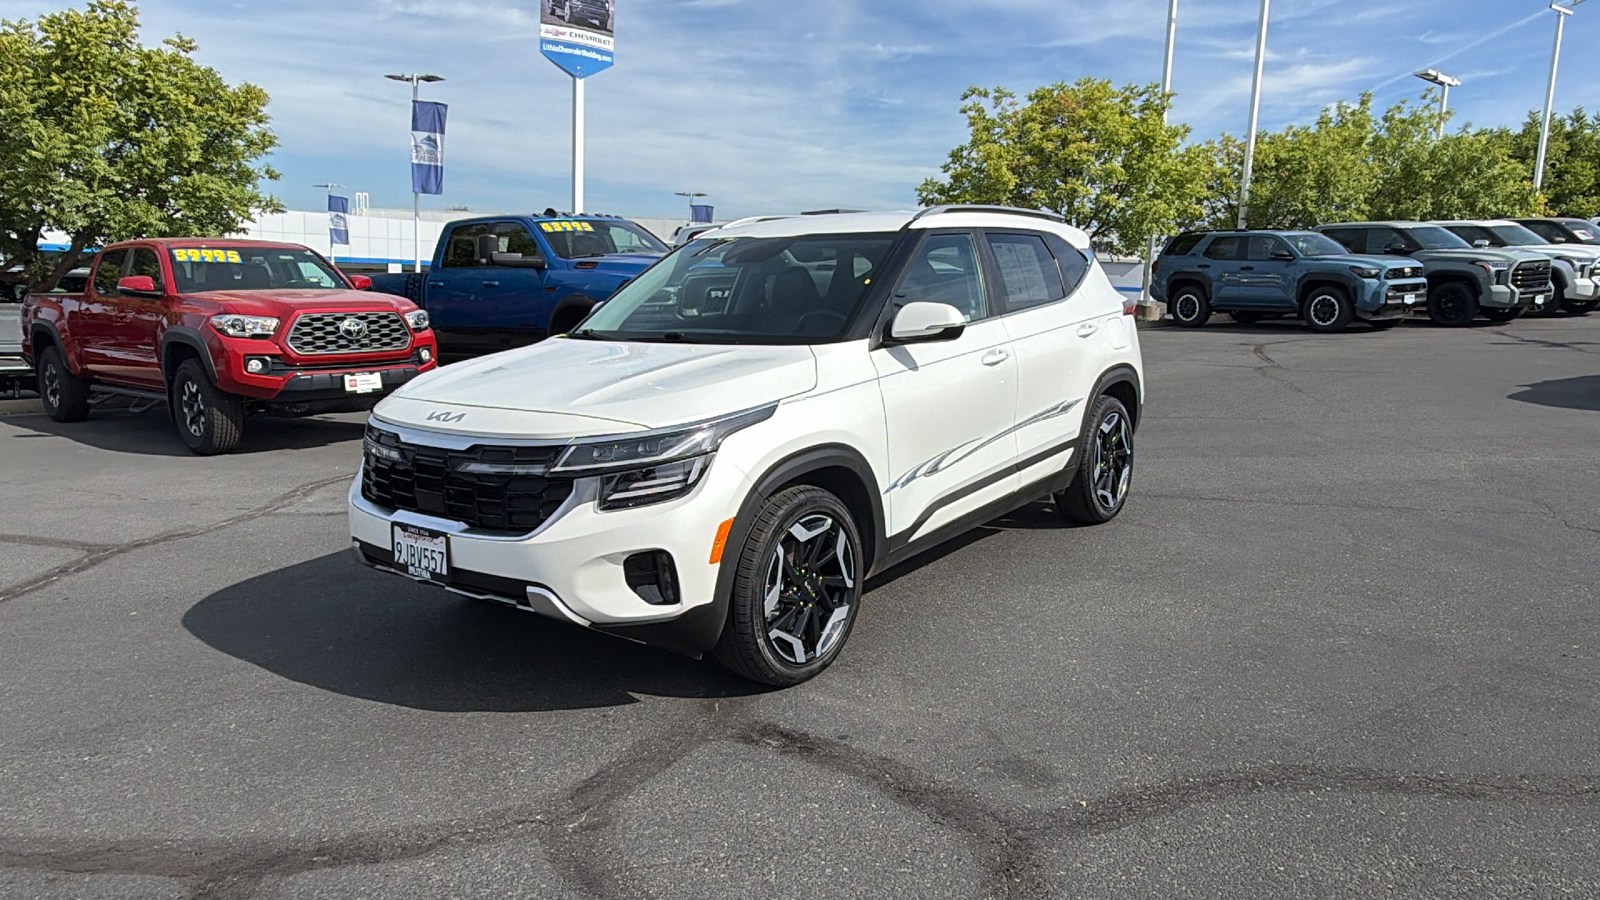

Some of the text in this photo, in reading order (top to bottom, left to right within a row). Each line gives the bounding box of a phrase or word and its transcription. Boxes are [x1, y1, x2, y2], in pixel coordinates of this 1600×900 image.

[569, 31, 611, 46] CHEVROLET
[174, 249, 241, 263] 39995
[426, 410, 467, 423] KIA
[396, 541, 445, 574] 9JBV557
